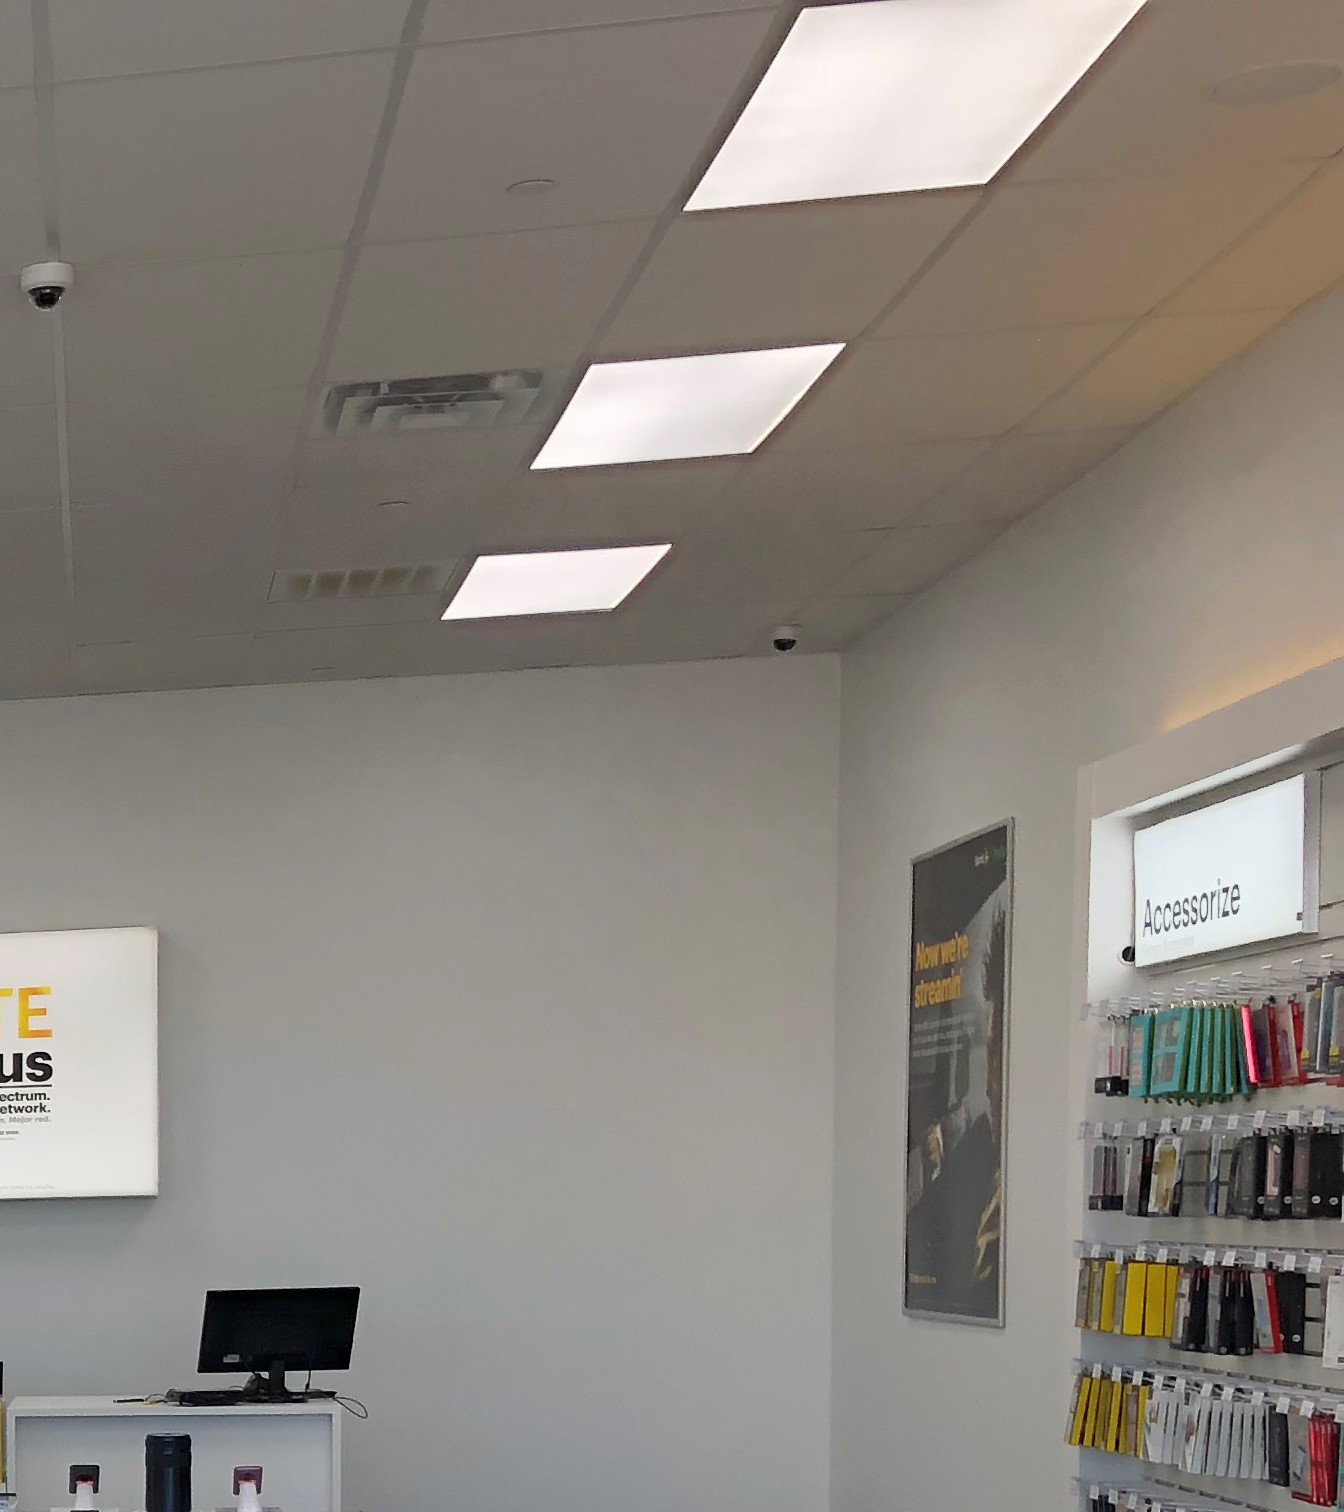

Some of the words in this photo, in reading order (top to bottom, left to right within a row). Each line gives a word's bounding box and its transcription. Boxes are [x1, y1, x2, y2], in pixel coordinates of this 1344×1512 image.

[1143, 878, 1241, 938] Accessorize
[915, 940, 940, 972] Now
[941, 932, 970, 965] we're
